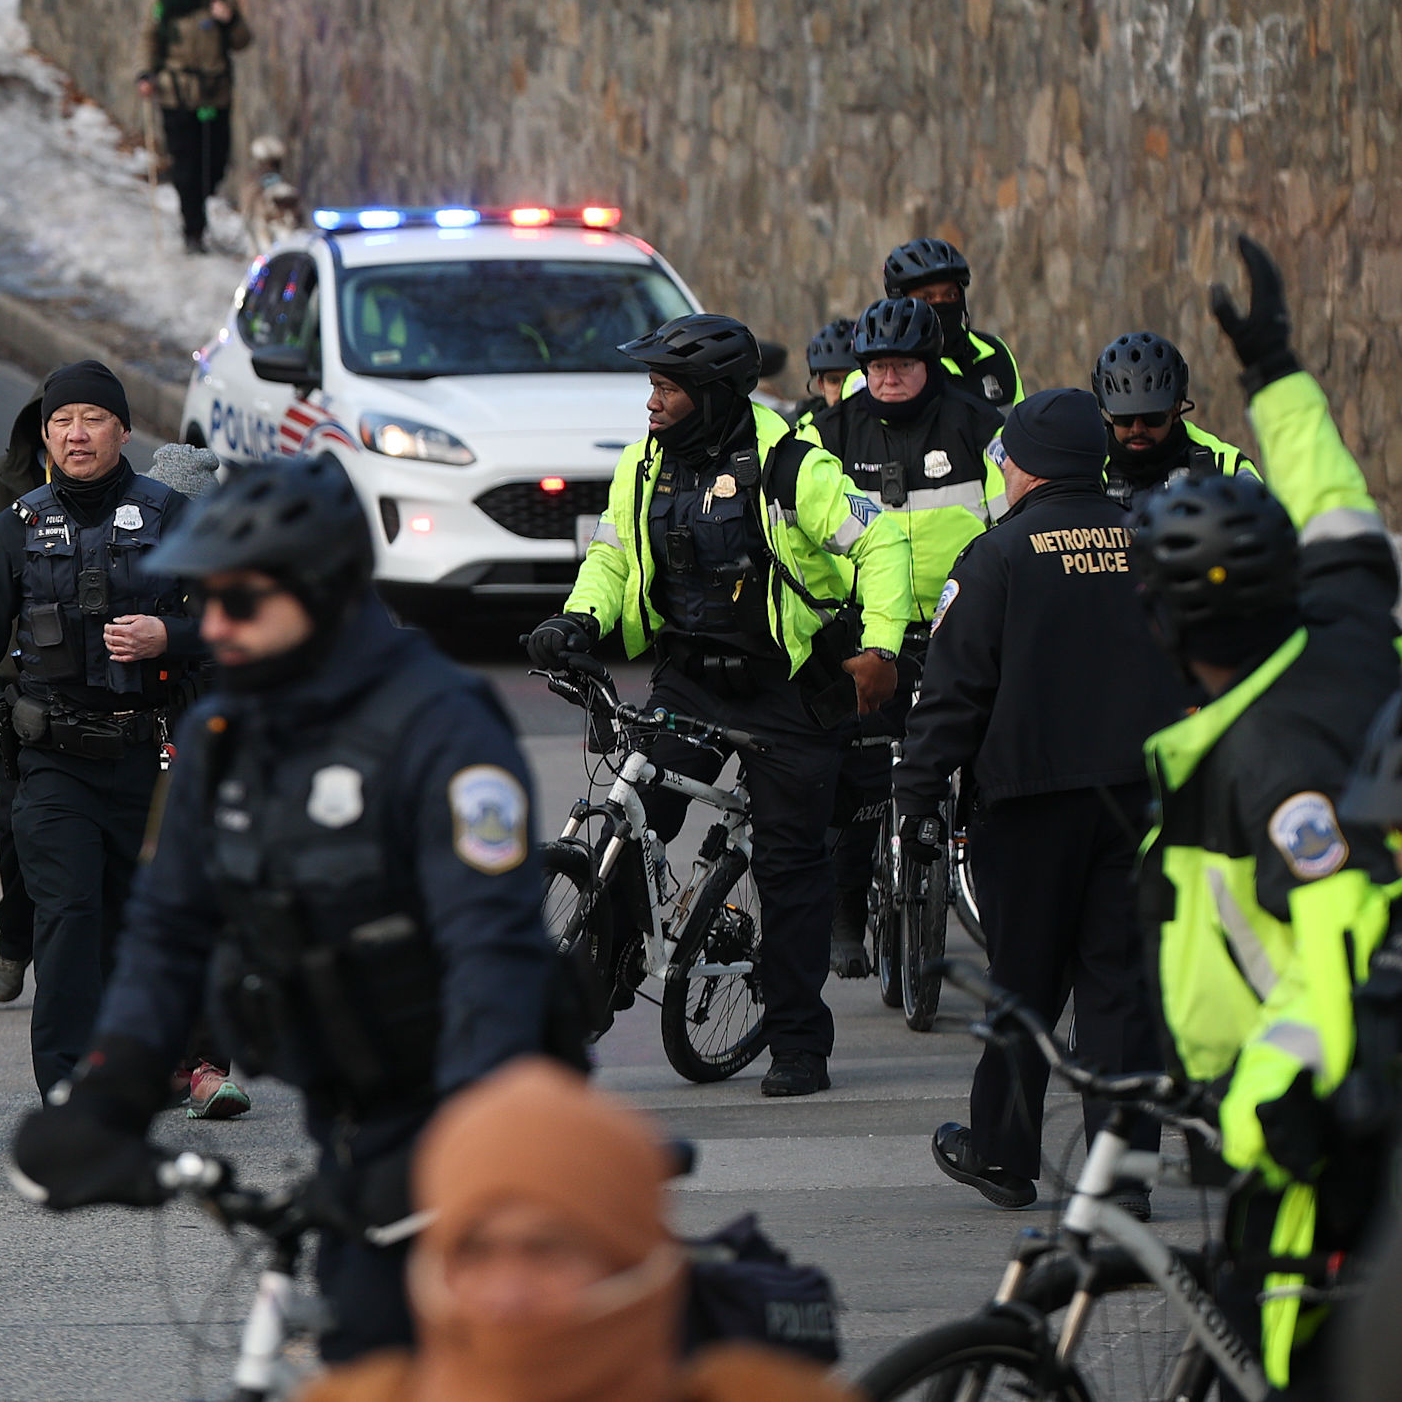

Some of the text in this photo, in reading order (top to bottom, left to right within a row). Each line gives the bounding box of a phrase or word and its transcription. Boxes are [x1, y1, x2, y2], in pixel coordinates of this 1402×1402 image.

[210, 398, 277, 462] POLICE
[46, 515, 64, 524] POLICE
[1061, 551, 1130, 575] POLICE
